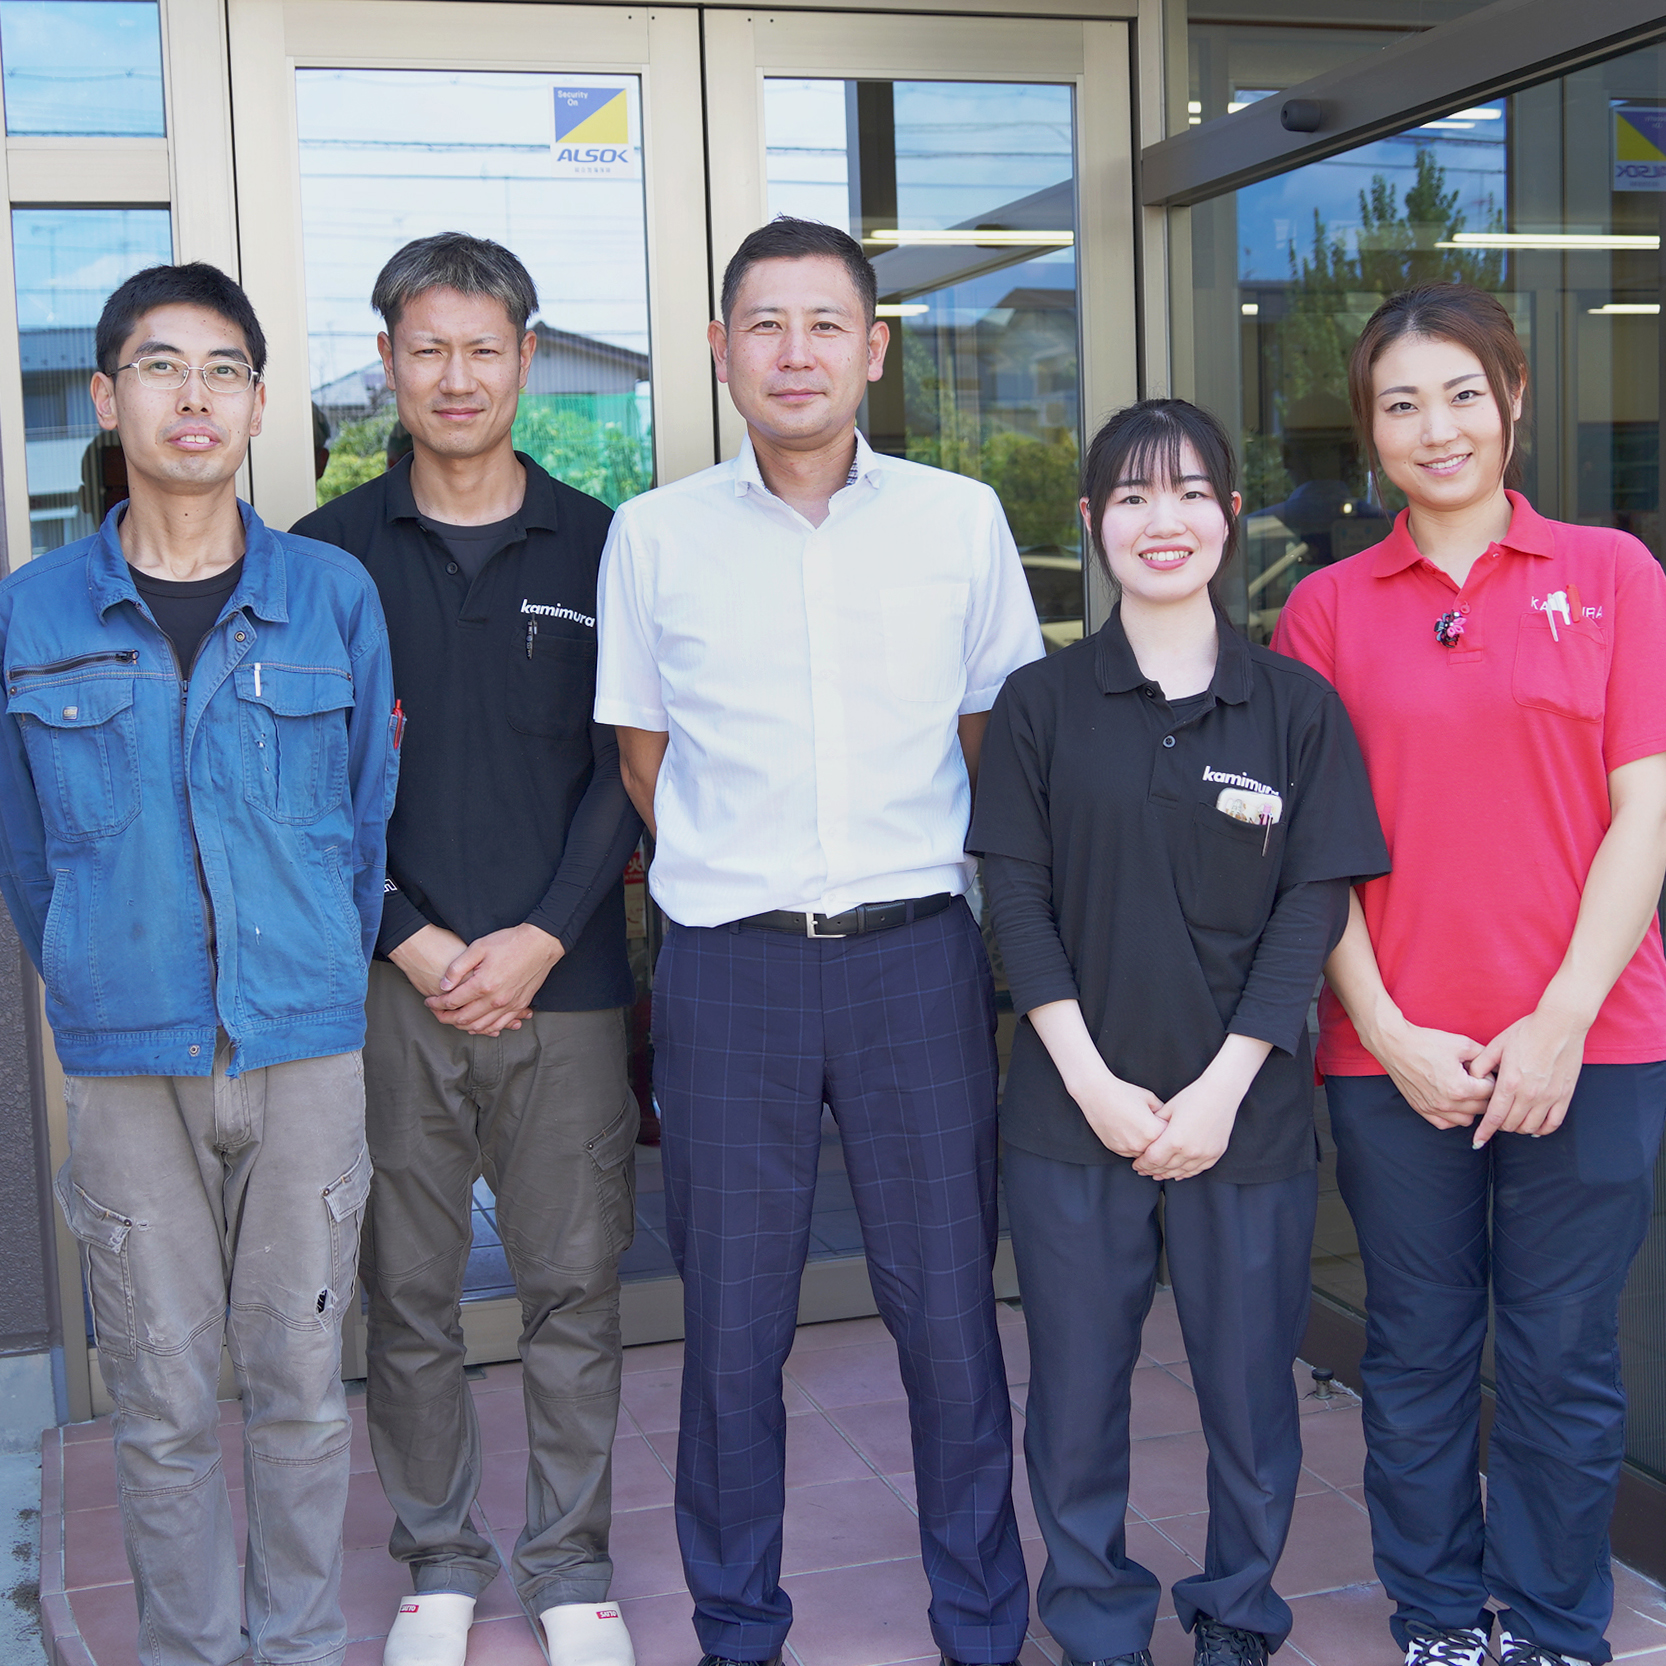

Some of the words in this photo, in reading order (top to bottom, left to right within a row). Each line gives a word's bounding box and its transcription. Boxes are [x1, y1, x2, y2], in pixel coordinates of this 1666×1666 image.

[557, 90, 588, 99] Security
[567, 98, 578, 107] On
[556, 148, 629, 164] ALSOK
[520, 598, 596, 628] kamimura
